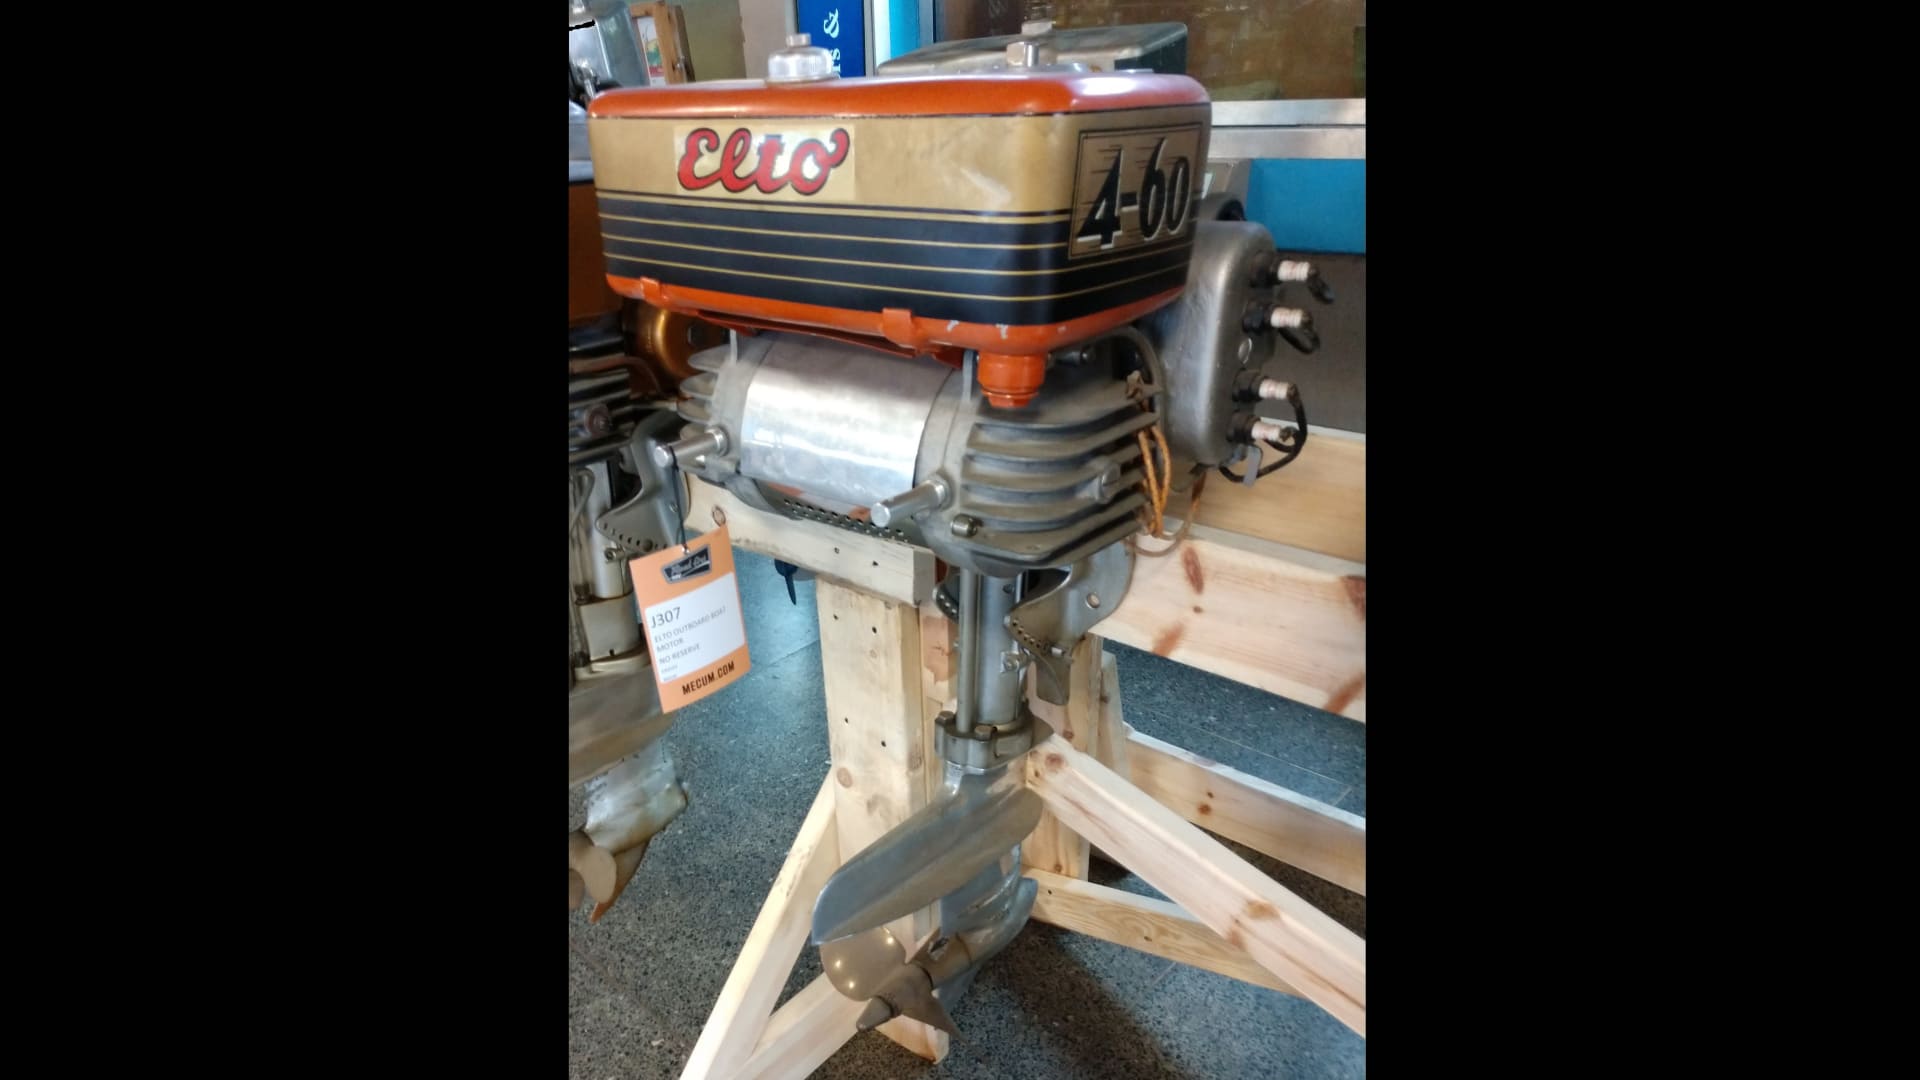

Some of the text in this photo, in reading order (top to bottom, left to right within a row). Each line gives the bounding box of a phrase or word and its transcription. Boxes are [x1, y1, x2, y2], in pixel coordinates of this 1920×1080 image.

[823, 7, 840, 38] &
[677, 127, 850, 196] Elto
[1077, 137, 1190, 249] 4-60
[651, 606, 681, 629] J307
[654, 605, 727, 643] ELTO OUTBOARD BOAT
[656, 637, 684, 652] MOTOR
[659, 643, 701, 664] NO RESERVE
[682, 661, 735, 695] MECUM.COM
